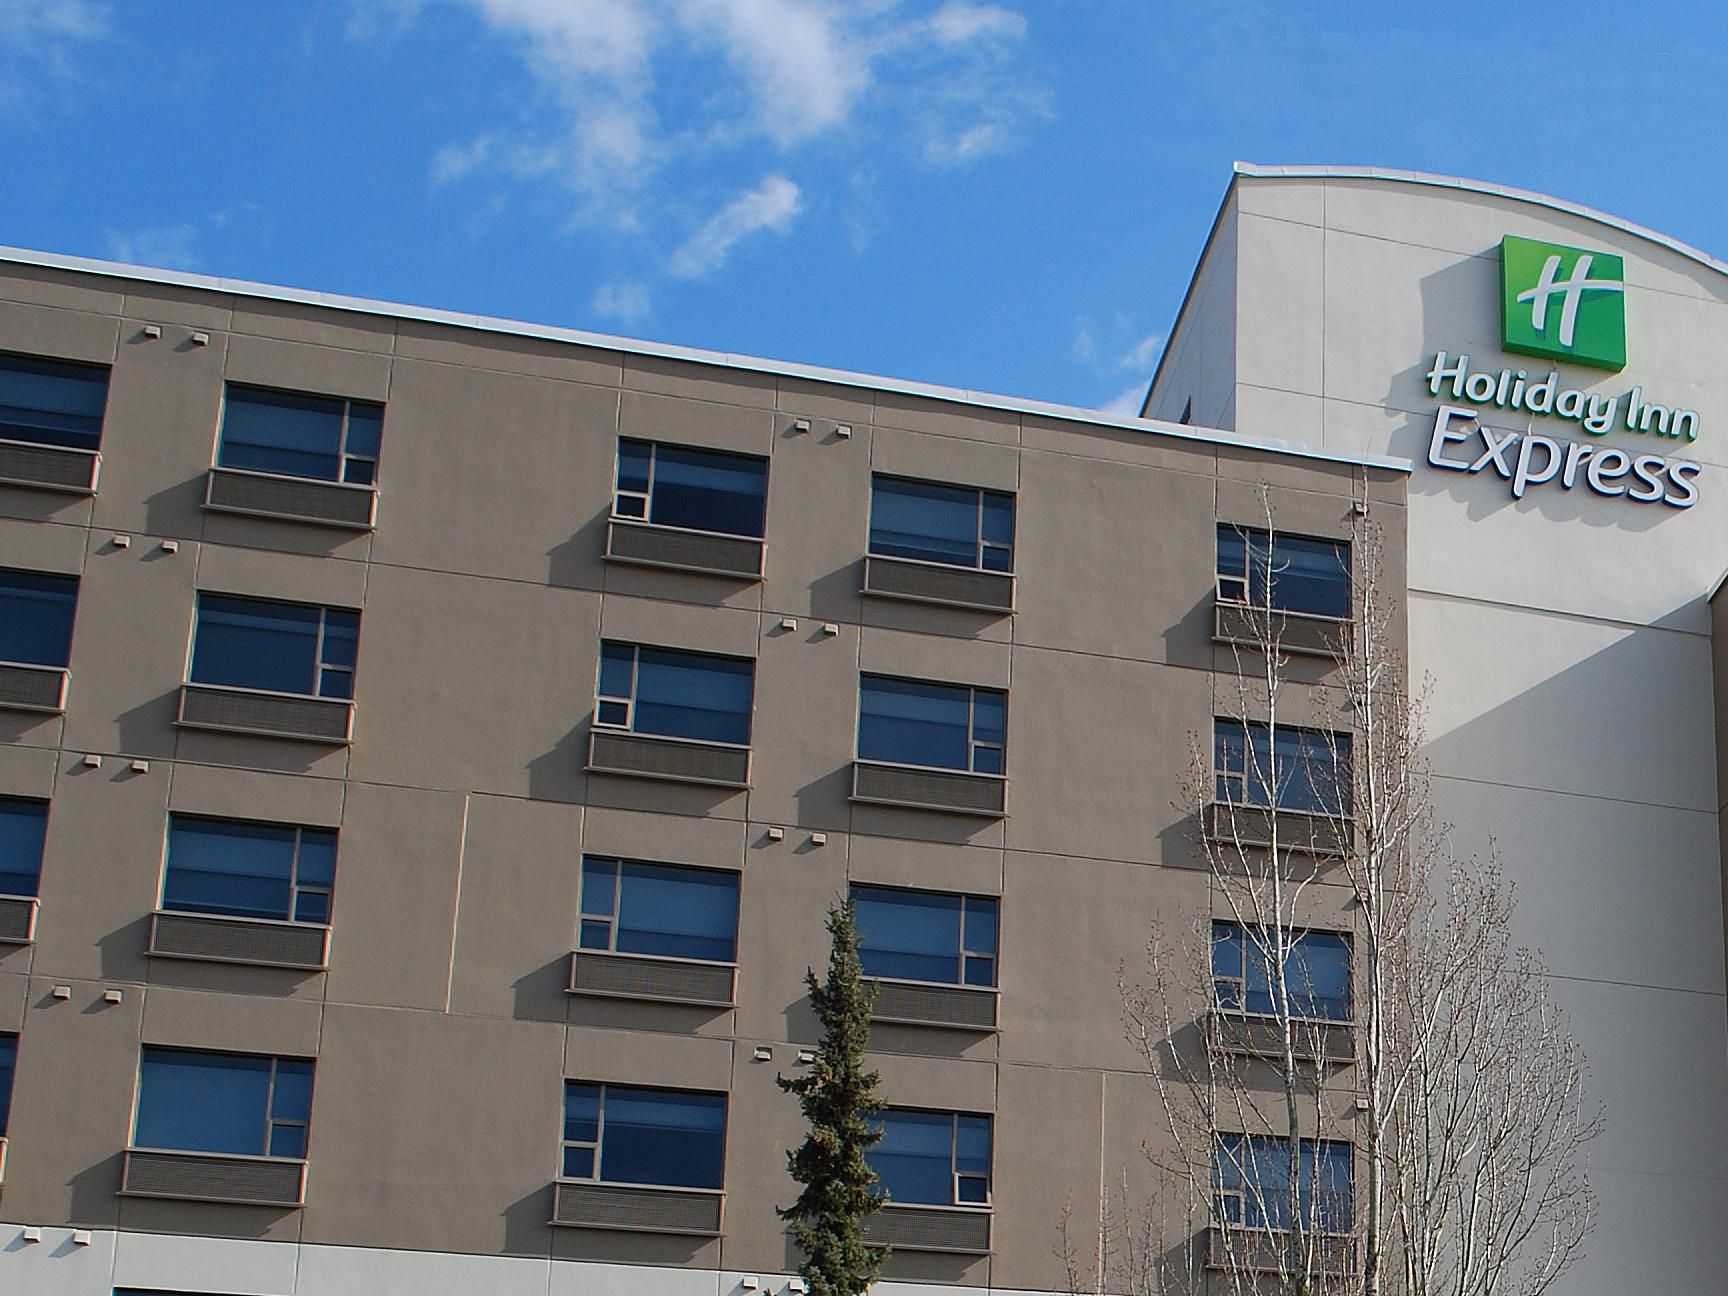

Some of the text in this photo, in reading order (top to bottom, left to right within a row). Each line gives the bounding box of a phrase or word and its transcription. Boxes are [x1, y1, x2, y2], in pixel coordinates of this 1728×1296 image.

[1426, 351, 1701, 441] Holiday Inn
[1428, 405, 1702, 509] Express
